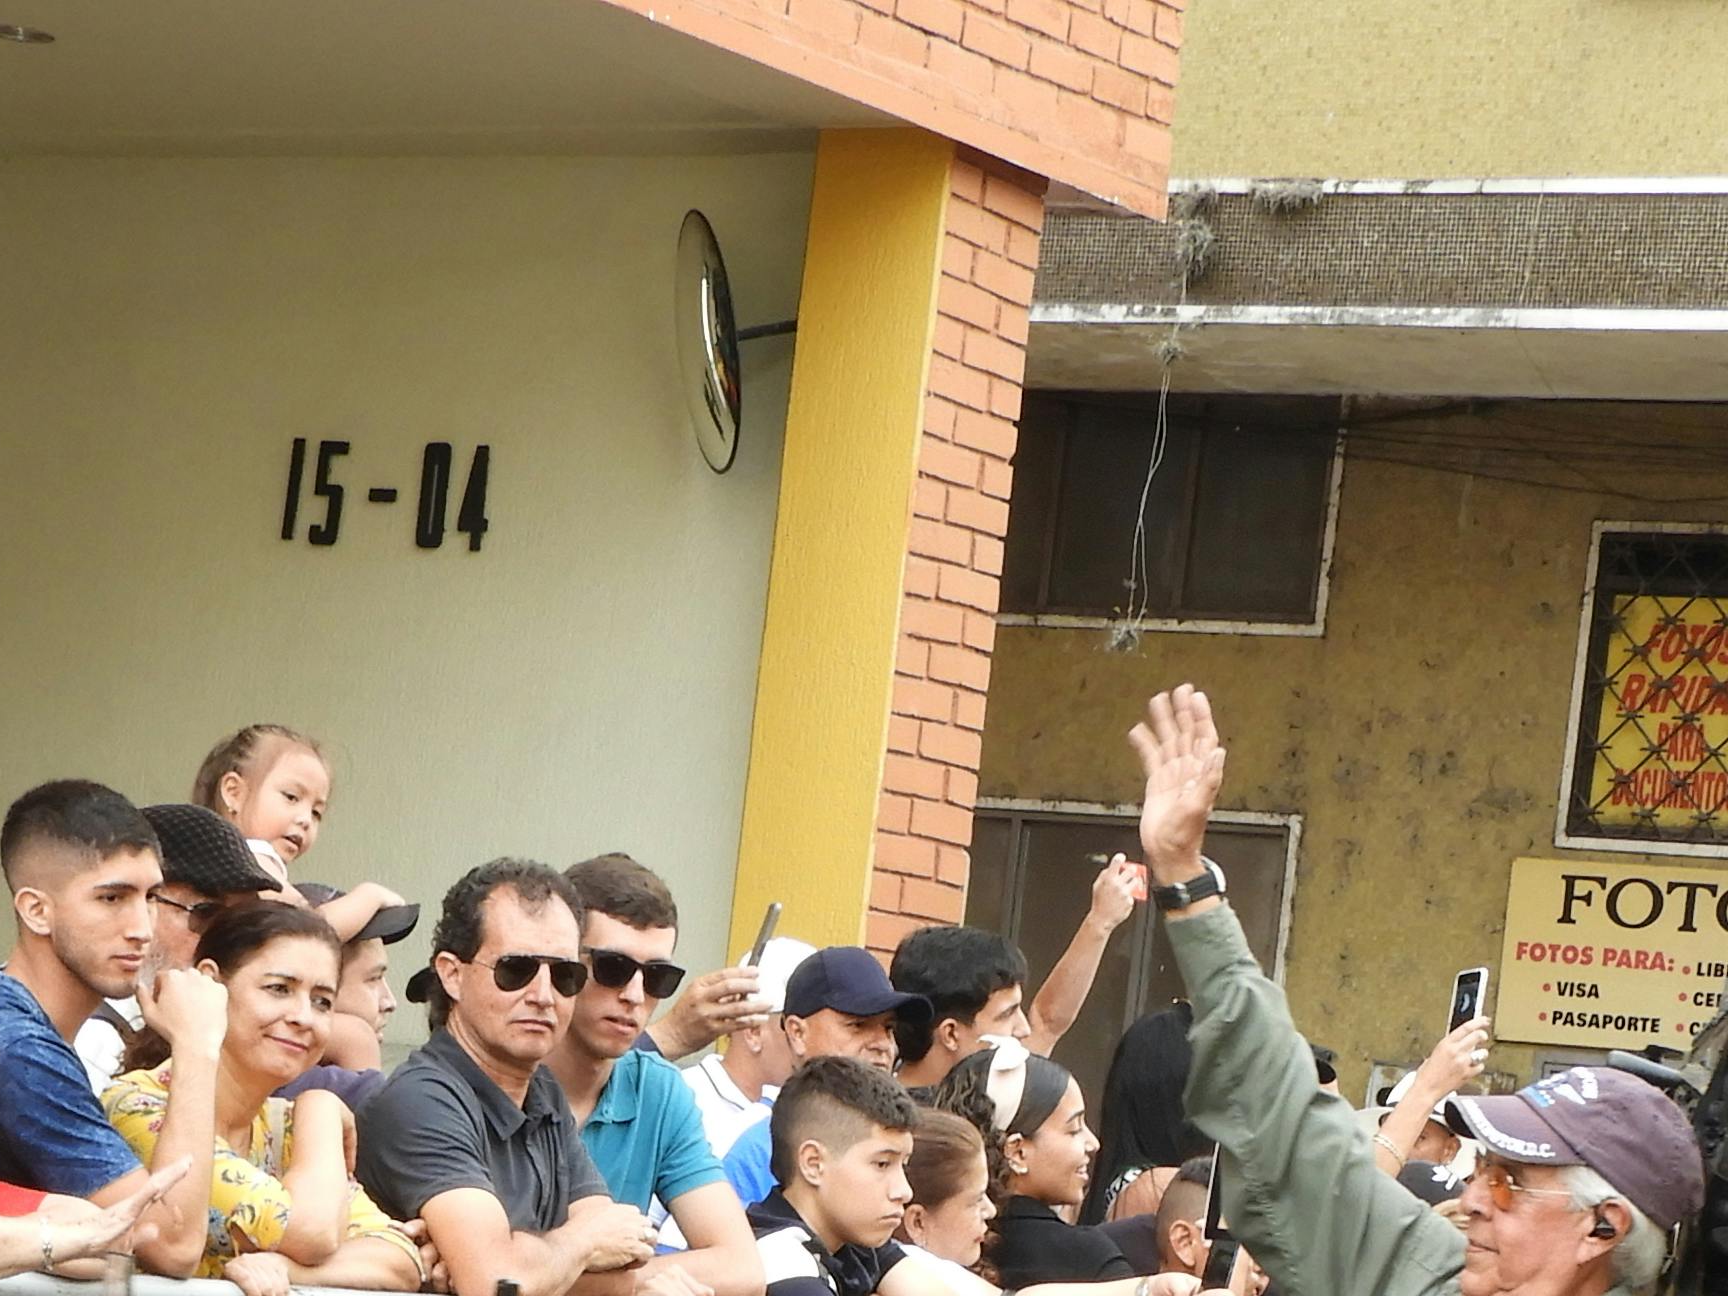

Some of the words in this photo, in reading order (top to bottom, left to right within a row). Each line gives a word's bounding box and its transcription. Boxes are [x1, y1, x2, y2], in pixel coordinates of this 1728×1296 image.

[281, 437, 490, 552] 15-04
[1655, 722, 1706, 762] PARA
[1515, 942, 1594, 967] FOTOS
[1601, 947, 1675, 972] PARA:
[1556, 981, 1600, 999] VISA
[1551, 1011, 1661, 1034] PASAPORTE
